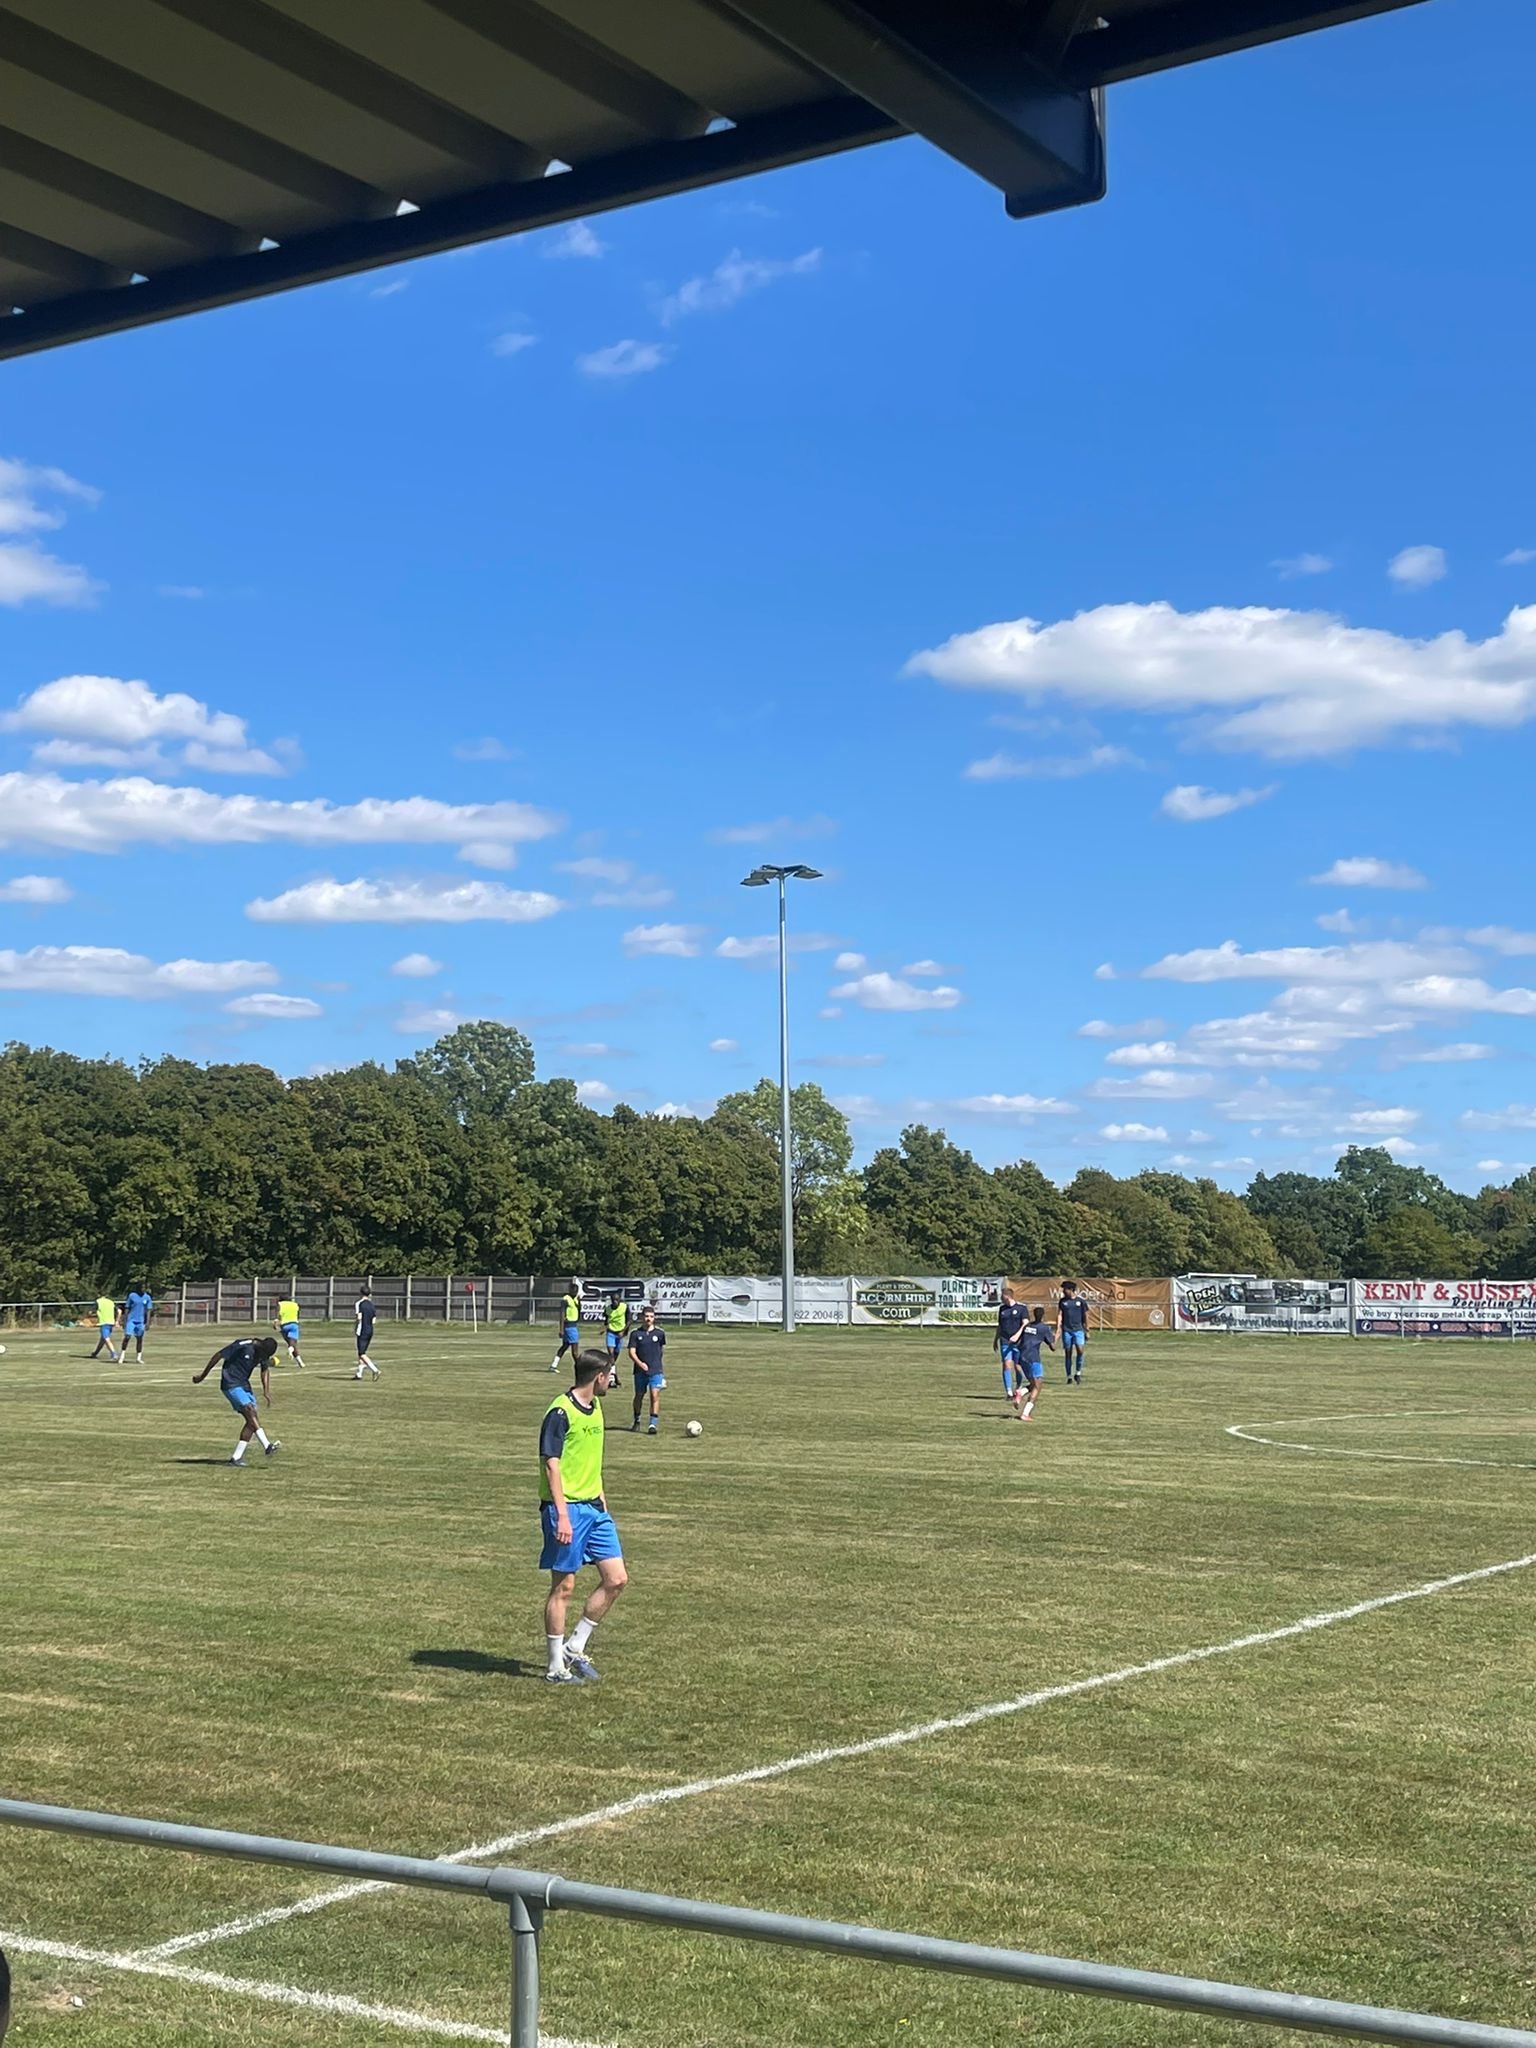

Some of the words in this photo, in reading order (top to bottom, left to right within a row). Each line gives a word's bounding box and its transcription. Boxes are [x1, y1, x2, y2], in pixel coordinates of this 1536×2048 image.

[656, 1281, 703, 1289] LOWLOADER
[942, 1280, 969, 1294] PLANT
[859, 1292, 902, 1304] ACORN
[905, 1294, 933, 1303] HIRE
[1364, 1283, 1426, 1300] KENT
[1433, 1283, 1449, 1300] &
[1457, 1283, 1536, 1301] SUSSEX
[938, 1294, 959, 1308] TOOL
[962, 1294, 982, 1308] HIRE
[1452, 1296, 1514, 1312] Recycling
[879, 1307, 911, 1318] .com
[1377, 1309, 1392, 1319] buy
[1394, 1311, 1413, 1320] your
[1415, 1311, 1440, 1320] scrap
[1442, 1310, 1466, 1318] metal
[1467, 1310, 1476, 1319] &
[1476, 1311, 1501, 1321] scrap
